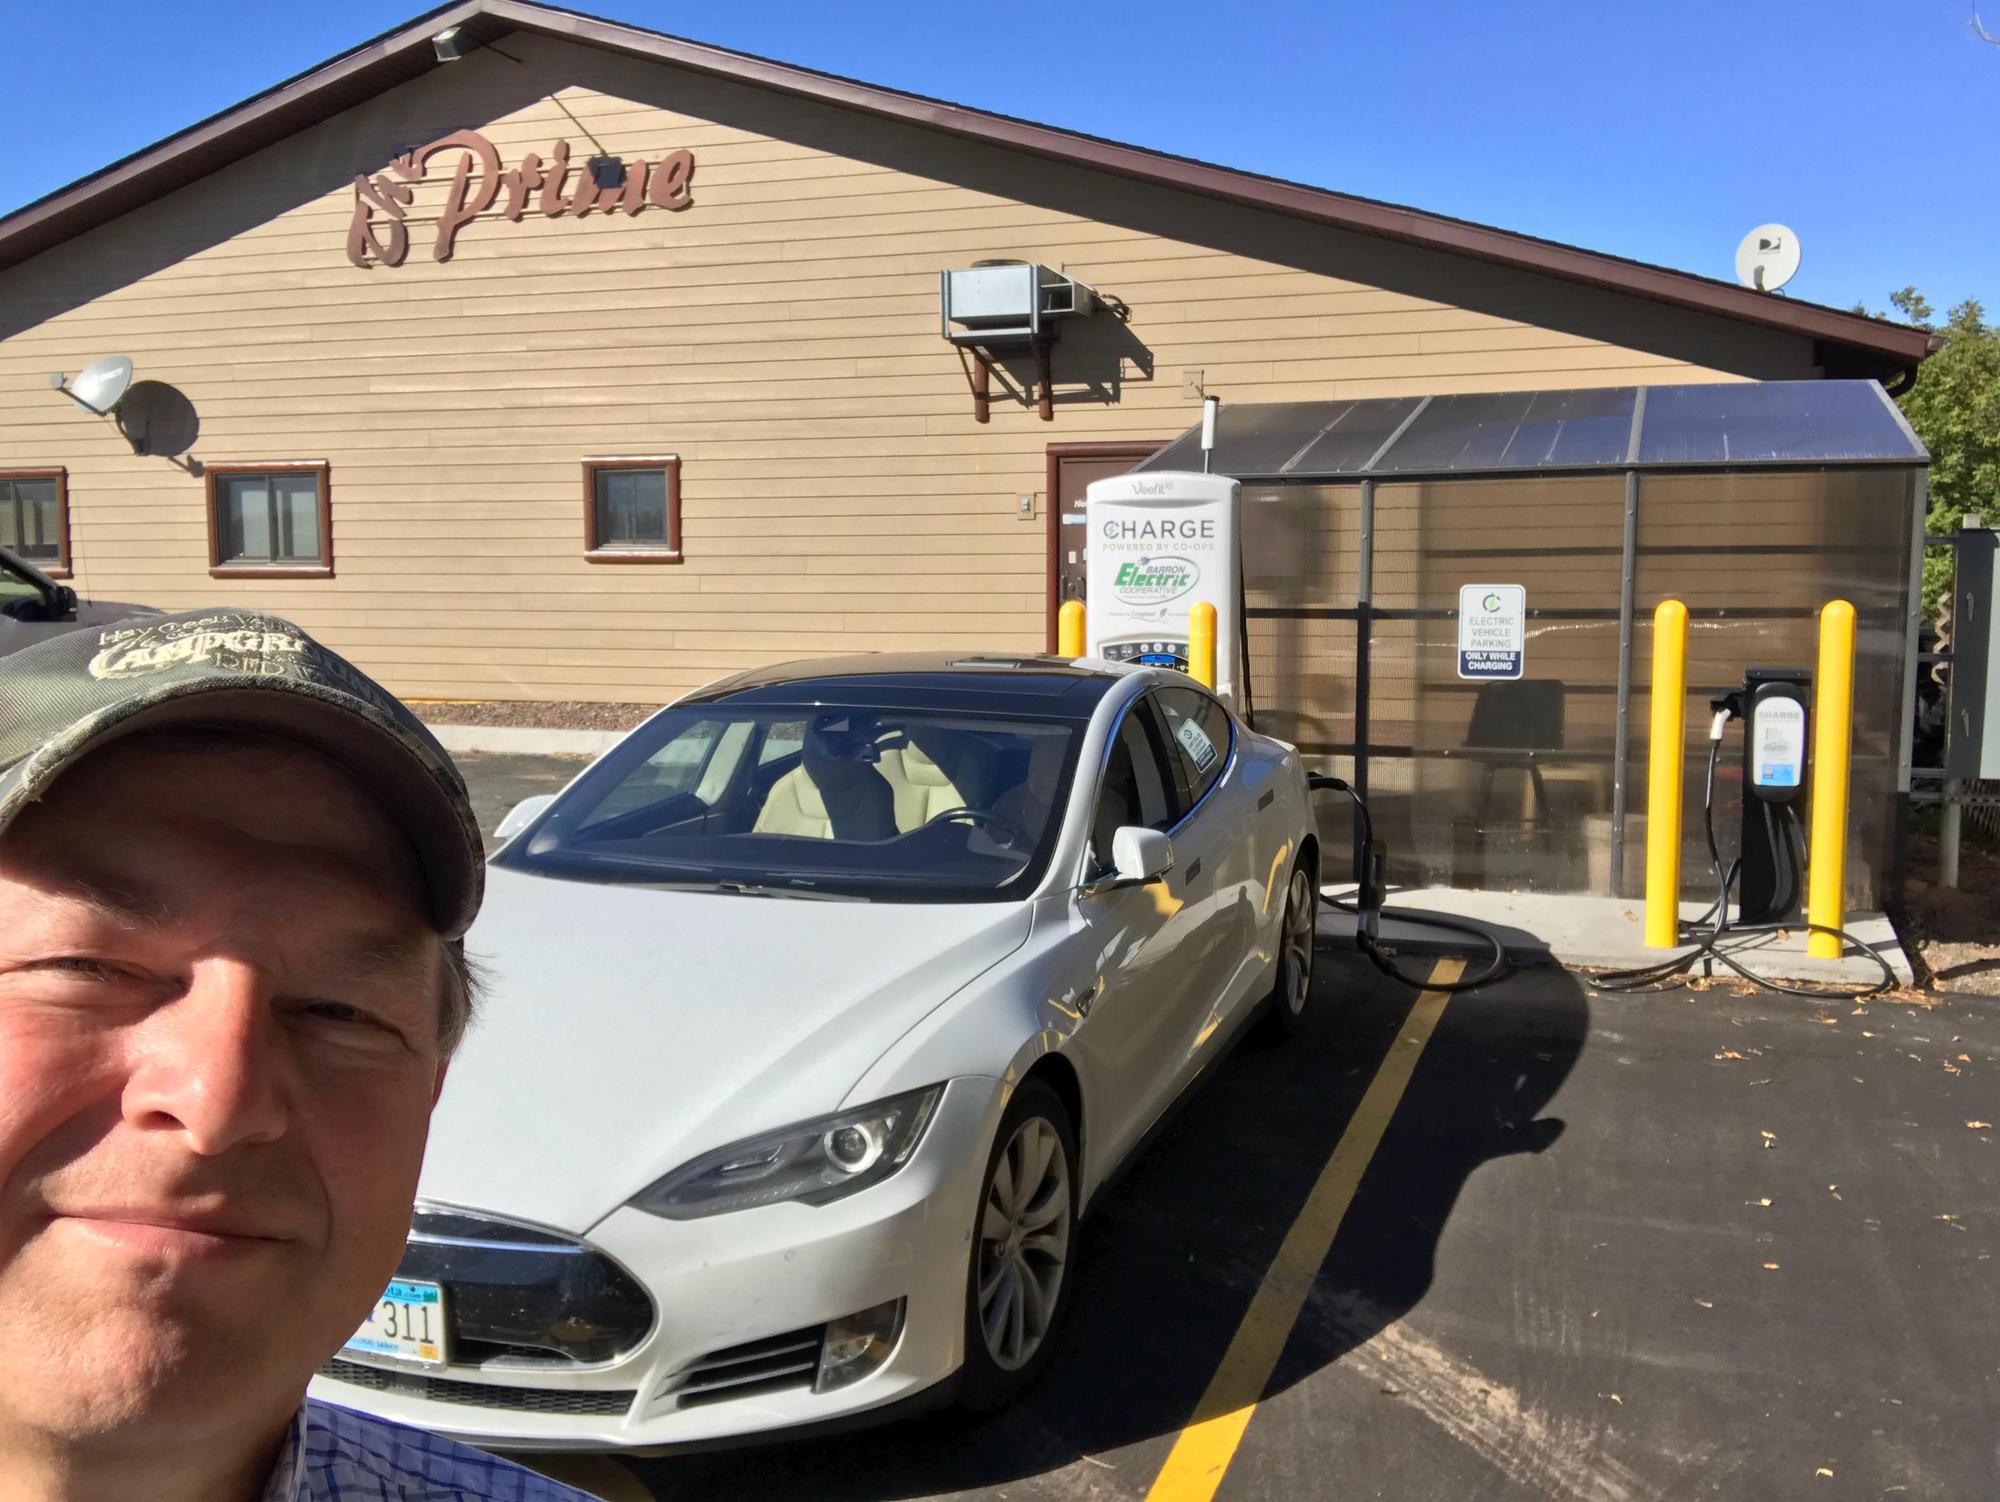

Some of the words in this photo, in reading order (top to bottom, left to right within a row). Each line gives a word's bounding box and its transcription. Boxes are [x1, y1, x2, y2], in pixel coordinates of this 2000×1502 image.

[391, 129, 694, 263] Prime
[1104, 520, 1215, 539] CHARGE
[1102, 543, 1153, 551] POWERED
[1157, 543, 1169, 551] BY
[1174, 543, 1215, 551] CO-OPS
[1114, 563, 1190, 586] Electric
[1146, 566, 1186, 574] BARRON
[1469, 617, 1514, 626] ELECTRIC
[1472, 628, 1511, 637] VEHICLE
[1470, 639, 1511, 649] PARKING
[1465, 652, 1488, 660] ONLY
[1489, 652, 1516, 661] WHILE
[1468, 661, 1513, 670] CHARGING
[1759, 711, 1801, 720] CHARGE
[383, 1301, 434, 1344] 311
